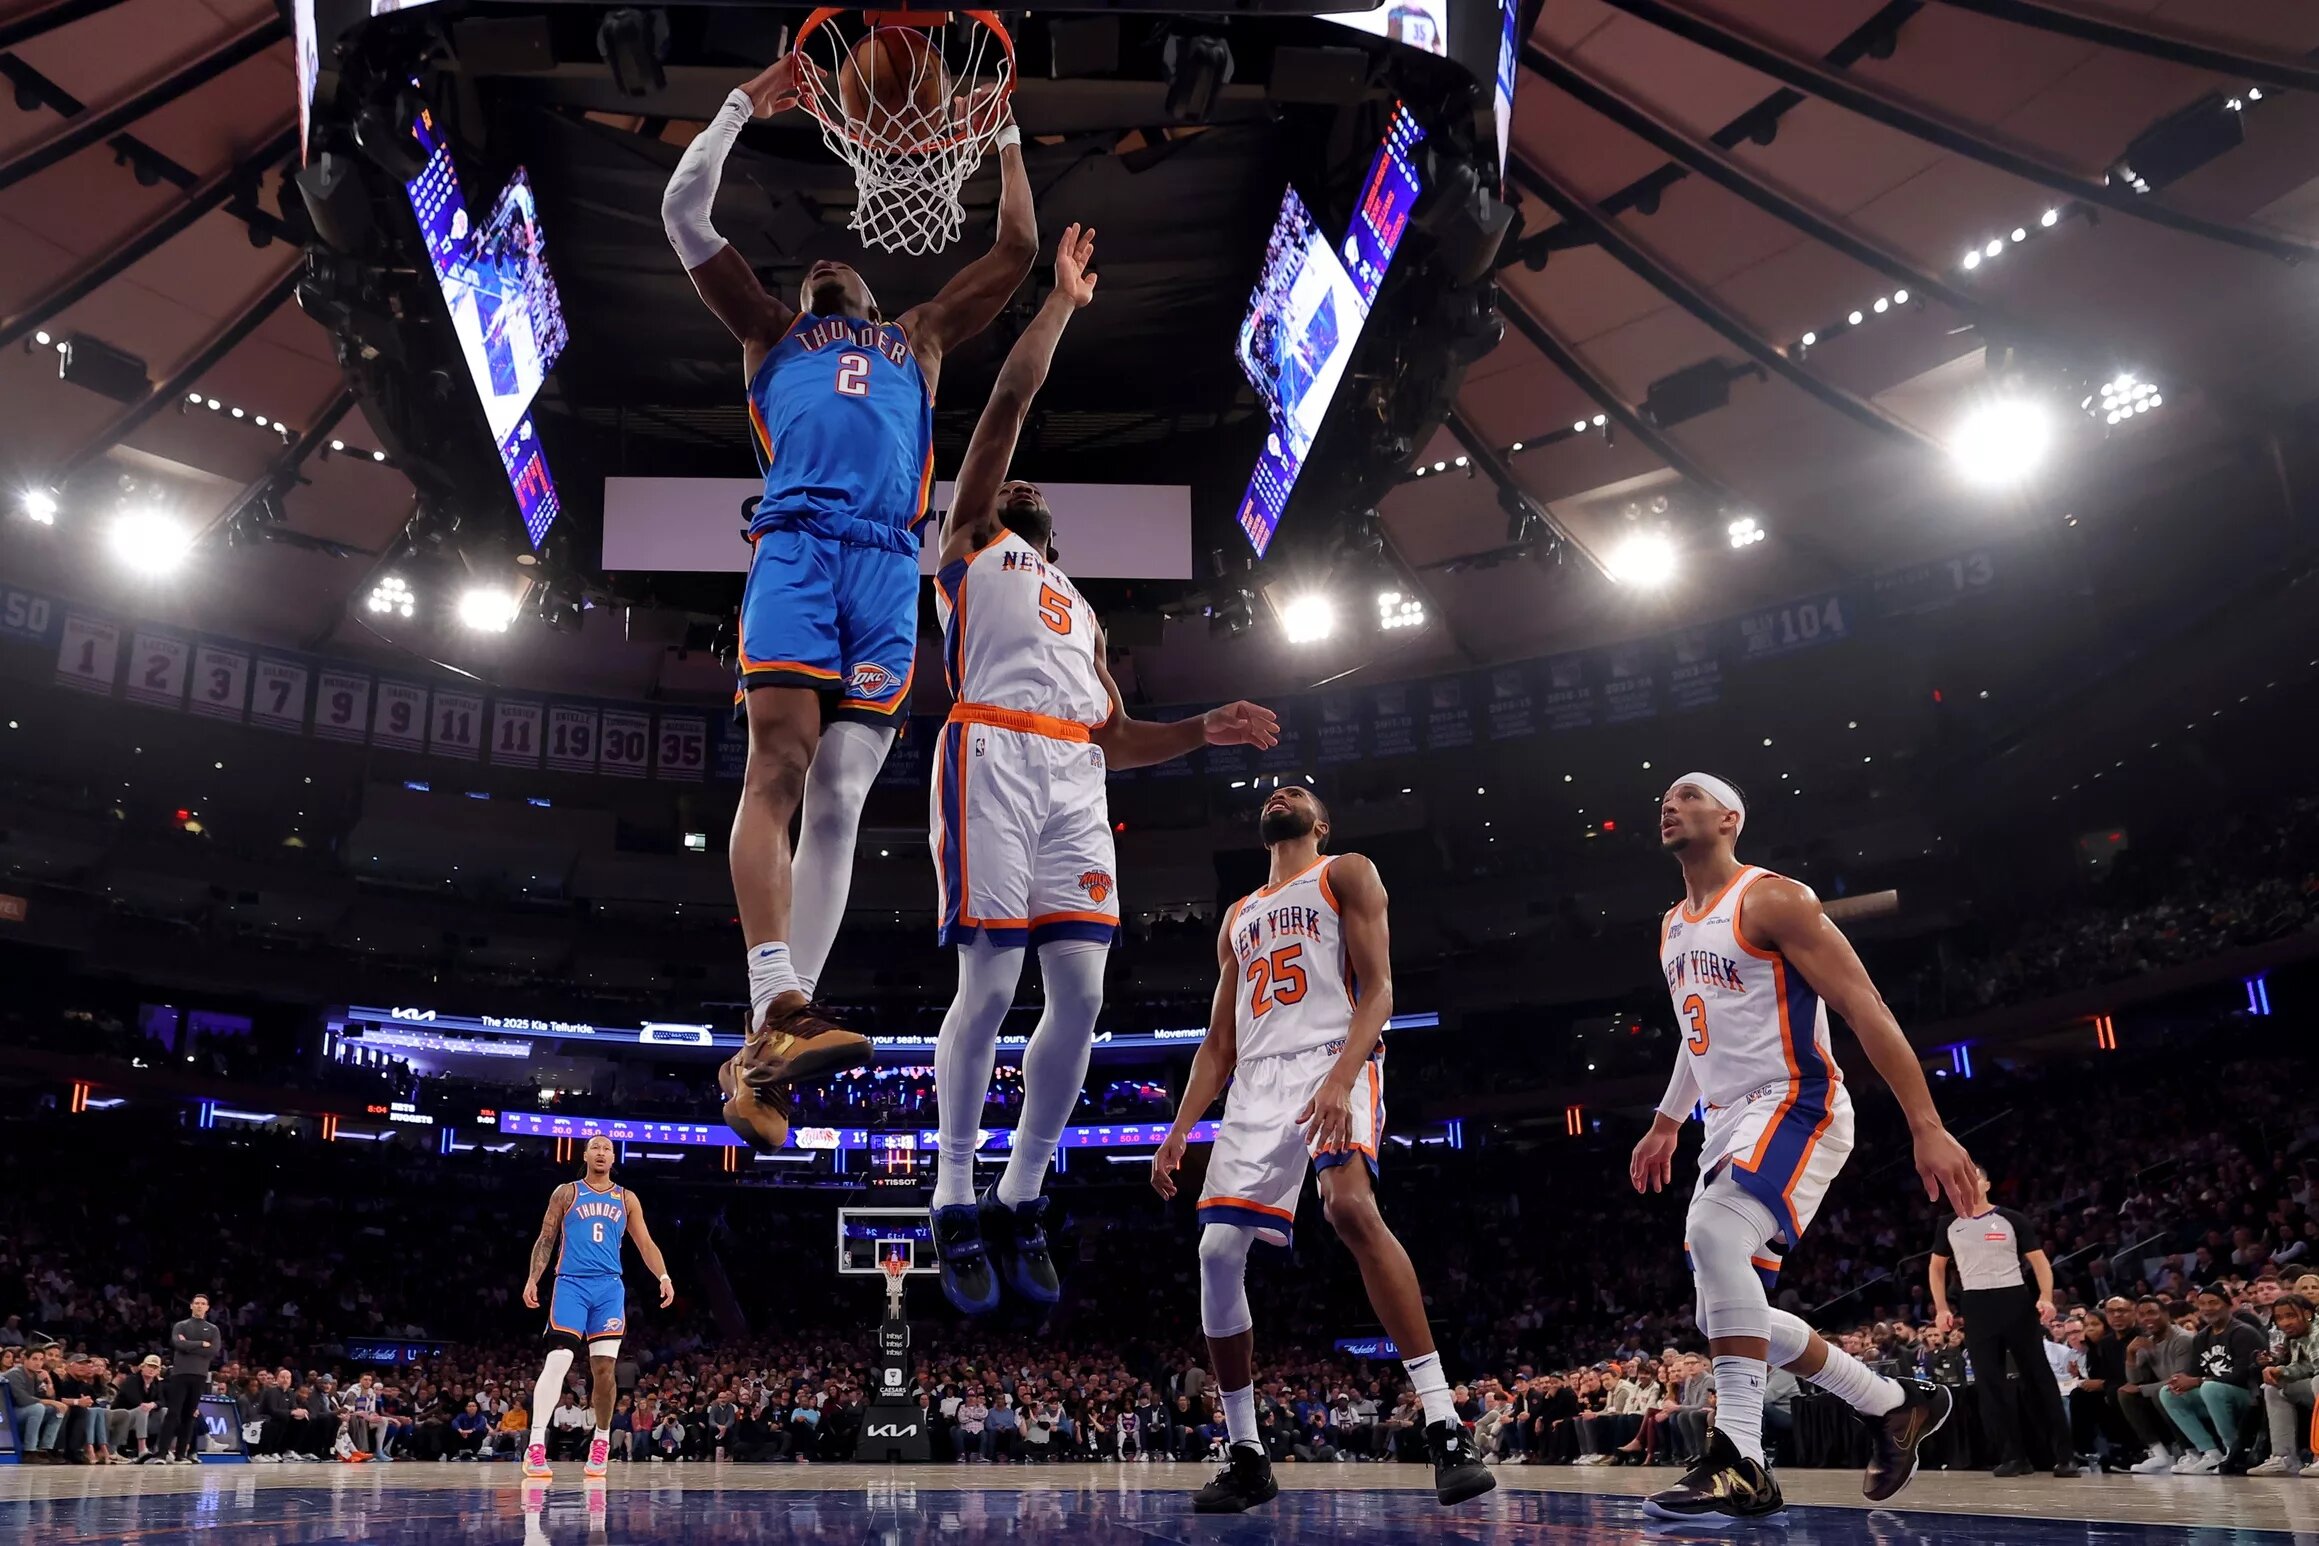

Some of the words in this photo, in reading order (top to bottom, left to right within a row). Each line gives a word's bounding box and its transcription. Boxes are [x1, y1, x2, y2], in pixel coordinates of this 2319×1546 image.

[1413, 24, 1426, 41] 35
[795, 321, 908, 366] THUNDER
[836, 353, 872, 397] 2
[1002, 551, 1046, 577] NEW
[1039, 582, 1072, 636] 5
[1781, 597, 1845, 644] 104
[78, 639, 94, 675] 1
[145, 654, 171, 689] 2
[208, 667, 232, 701] 3
[268, 679, 292, 713] 7
[331, 691, 353, 724] 9
[389, 700, 411, 734] 9
[440, 709, 471, 744] 11
[501, 719, 531, 752] 11
[553, 724, 590, 757] 19
[605, 729, 645, 762] 30
[662, 733, 703, 765] 35
[1267, 906, 1321, 943] YORK
[1247, 943, 1307, 1020] 25
[1690, 950, 1746, 993] YORK
[482, 1015, 501, 1028] The
[503, 1017, 529, 1030] 2025
[531, 1019, 548, 1031] Kia
[550, 1021, 596, 1035] Telluride.
[872, 1035, 895, 1046] your
[897, 1034, 922, 1044] seats
[1004, 1035, 1028, 1044] ours.
[1155, 1027, 1206, 1039] Movement
[1683, 993, 1710, 1057] 3
[390, 1112, 433, 1124] NUGGETS
[511, 1122, 517, 1131] 4
[552, 1126, 572, 1135] 20.0
[609, 1129, 633, 1138] 100.0
[645, 1131, 652, 1139] 4
[680, 1133, 687, 1141] 3
[696, 1133, 706, 1142] 11
[1081, 1136, 1088, 1144] 3
[1102, 1135, 1109, 1143] 6
[1120, 1134, 1140, 1143] 50.0
[884, 1178, 917, 1186] TISSOT
[576, 1203, 623, 1223] THUNDER
[592, 1222, 603, 1243] 6
